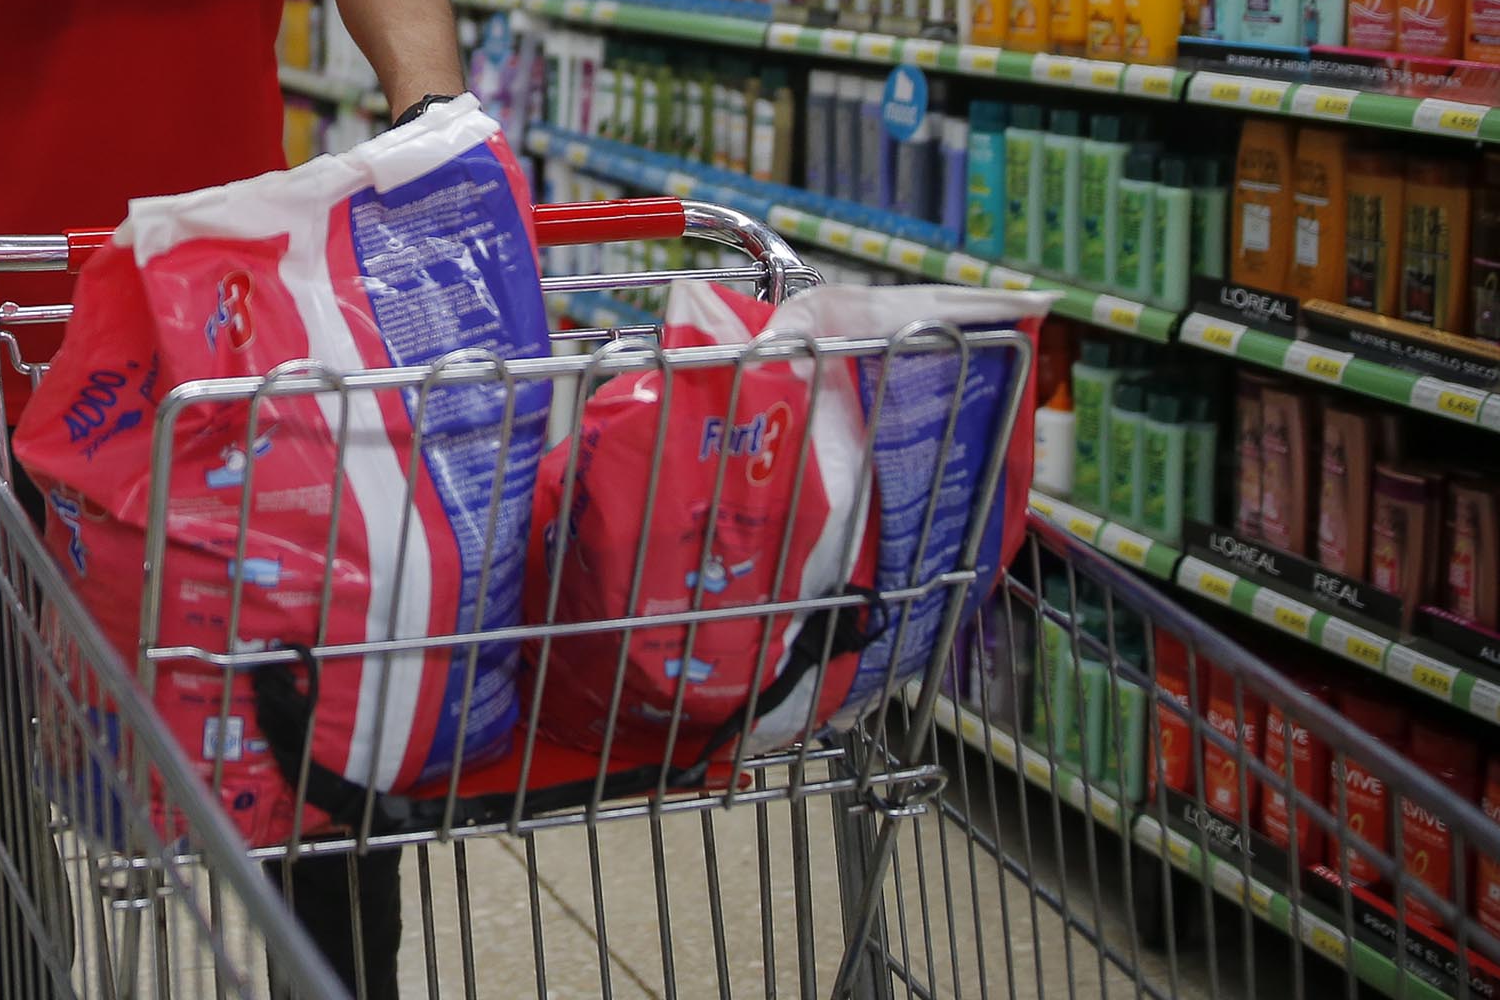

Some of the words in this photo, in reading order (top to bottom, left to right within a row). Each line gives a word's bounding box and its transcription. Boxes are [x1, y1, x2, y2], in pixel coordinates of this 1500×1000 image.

[1227, 54, 1270, 71] PURIFICA
[1311, 59, 1389, 81] RECONSTRUYE
[1414, 72, 1461, 88] PUNTAS
[1406, 345, 1462, 371] CABELLO
[1463, 362, 1499, 380] SECO
[63, 370, 127, 443] 4000
